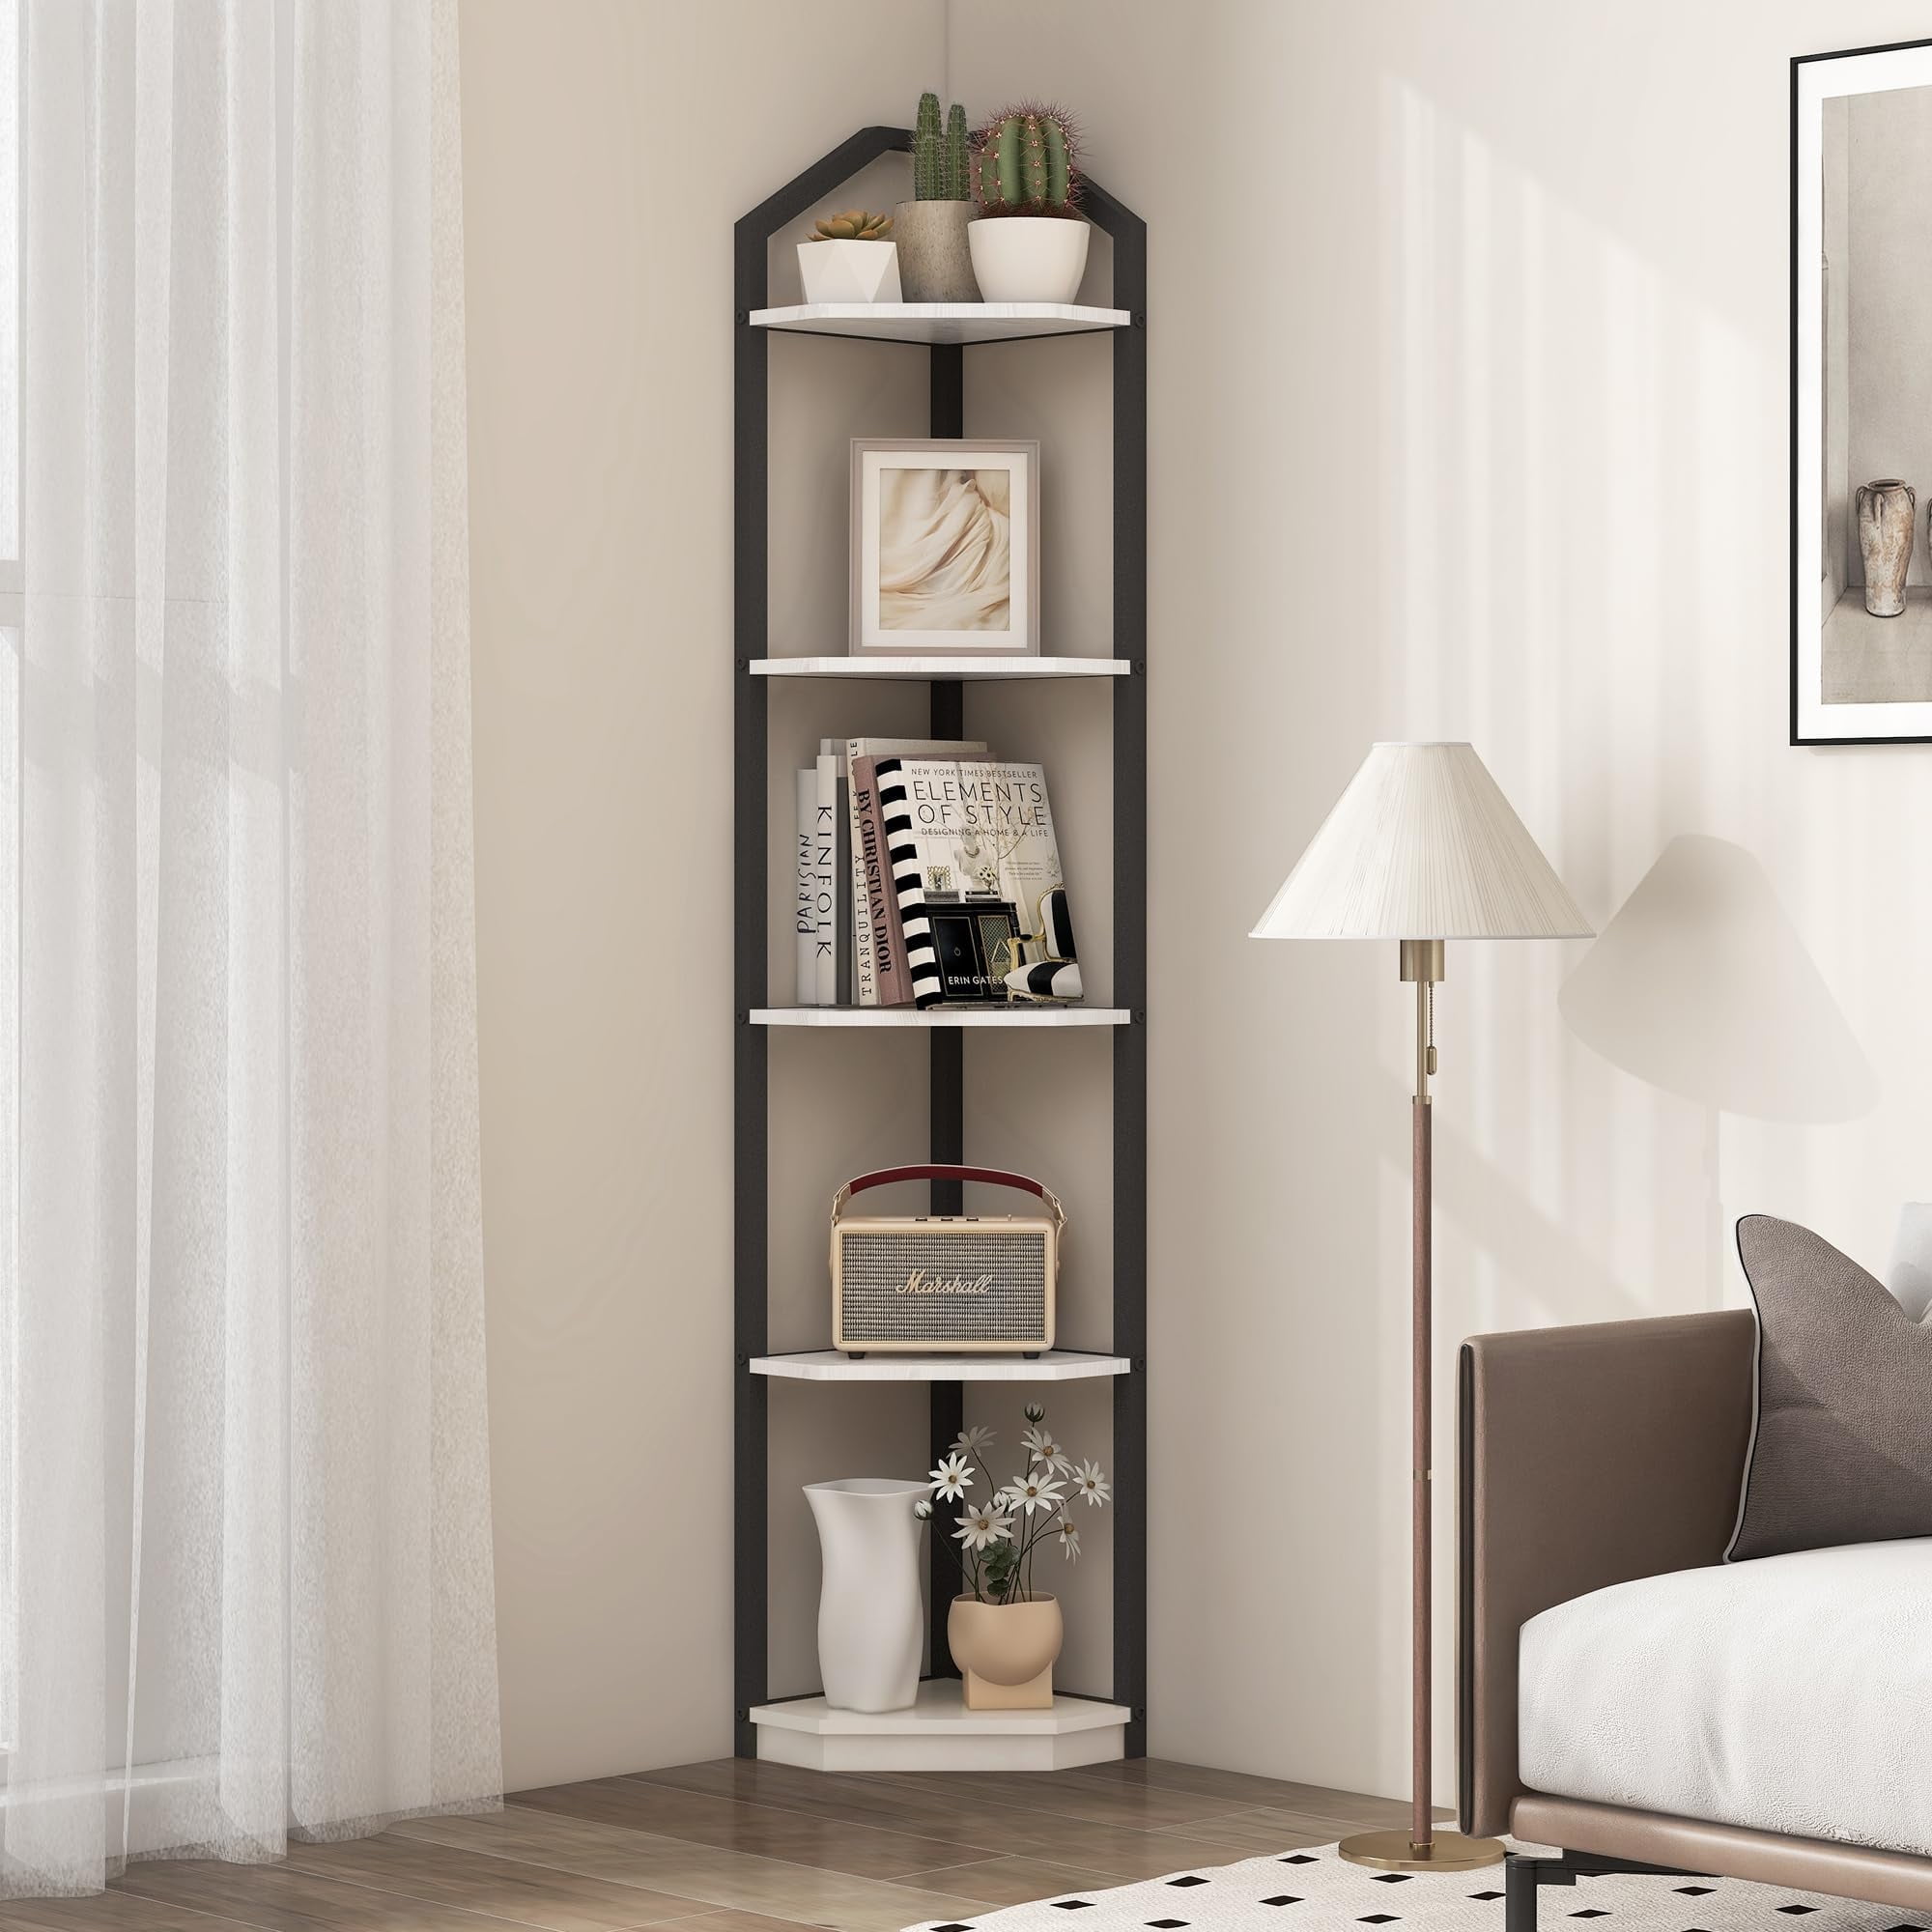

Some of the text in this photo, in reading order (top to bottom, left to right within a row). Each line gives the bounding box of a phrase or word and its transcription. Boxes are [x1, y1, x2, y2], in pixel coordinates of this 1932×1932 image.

[933, 768, 955, 777] YORK
[986, 770, 1037, 779] BESTSELLER
[913, 781, 1042, 803] ELEMENTS
[918, 804, 1047, 825] OF STYLE
[921, 828, 972, 837] DESIGNING
[796, 834, 817, 934] PARISIAN
[816, 806, 833, 959] KINFOLK
[858, 788, 893, 975] BY CHRISTIAN DIOR
[855, 855, 872, 997] TRANQUILITY
[948, 976, 1004, 985] ERIN GATES
[895, 1267, 993, 1293] Marshall
